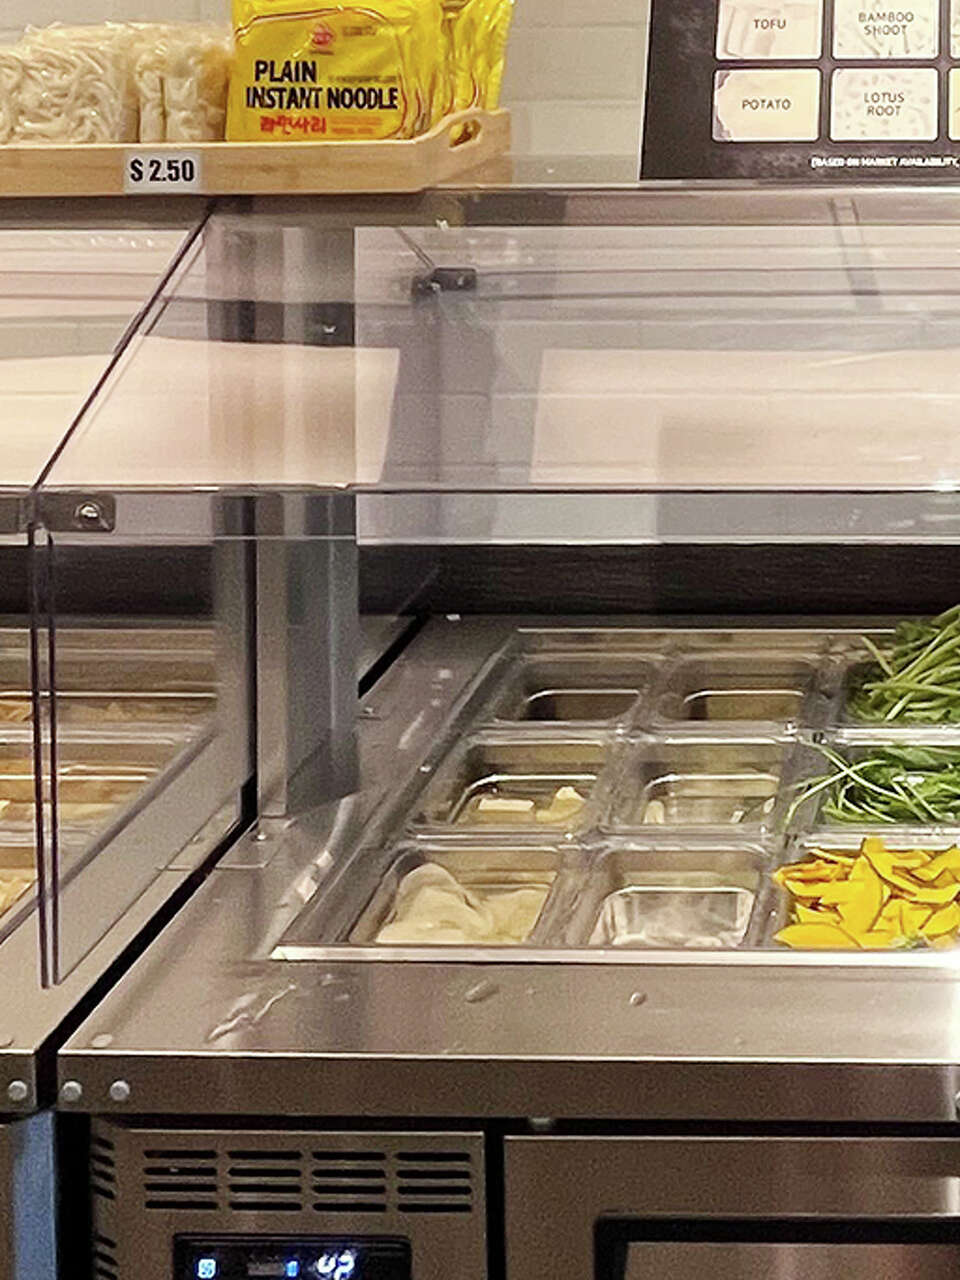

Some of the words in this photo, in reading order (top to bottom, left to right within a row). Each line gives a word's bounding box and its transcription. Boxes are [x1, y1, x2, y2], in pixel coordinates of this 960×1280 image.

[753, 18, 787, 30] TOFU
[857, 11, 915, 24] BAMBOO
[863, 24, 908, 37] SHOOT
[254, 59, 317, 83] PLAIN
[246, 86, 323, 110] INSTANT
[327, 87, 399, 110] NOODLE
[863, 91, 905, 104] LOTUS
[741, 98, 792, 111] POTATO
[866, 104, 902, 117] ROOT
